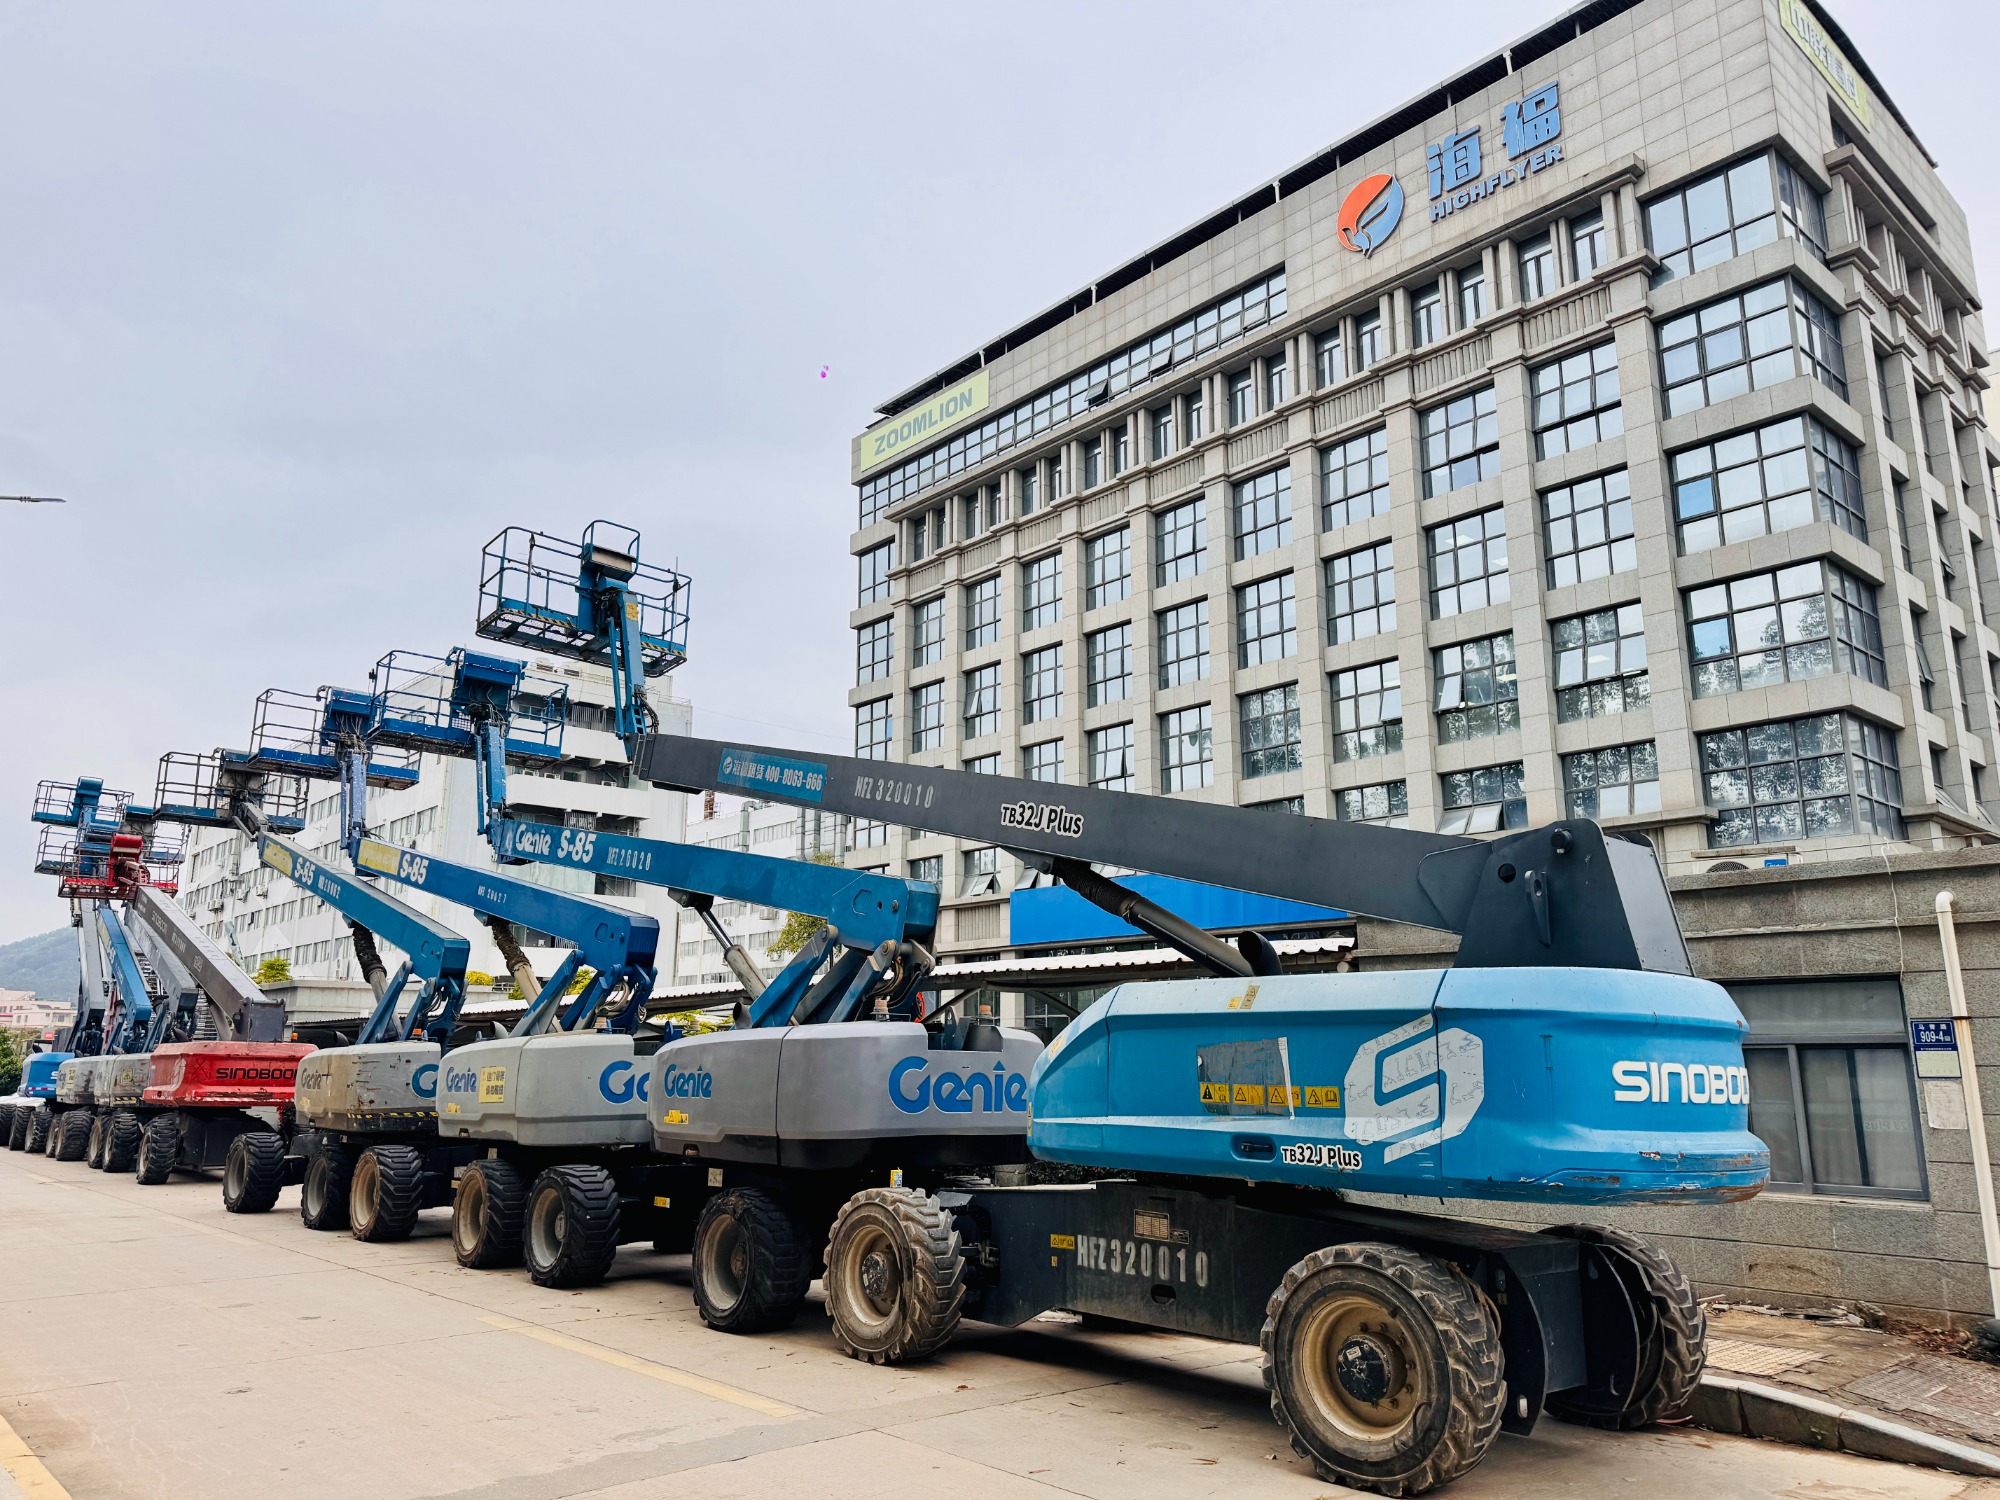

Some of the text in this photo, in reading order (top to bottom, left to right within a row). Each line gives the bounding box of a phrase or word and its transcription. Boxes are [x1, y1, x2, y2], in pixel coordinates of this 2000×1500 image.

[1430, 144, 1564, 222] HIGHFLYER
[874, 387, 973, 456] ZOOMLION
[1002, 802, 1083, 835] TB32J Plus
[515, 824, 552, 856] Genie
[557, 829, 597, 863] S-85
[400, 853, 430, 885] S-85
[1920, 1031, 1945, 1043] 909-4
[446, 1066, 477, 1093] Genie
[664, 1063, 712, 1099] Genie
[888, 1056, 1028, 1115] Genie
[1282, 1145, 1361, 1168] TB32J Plus
